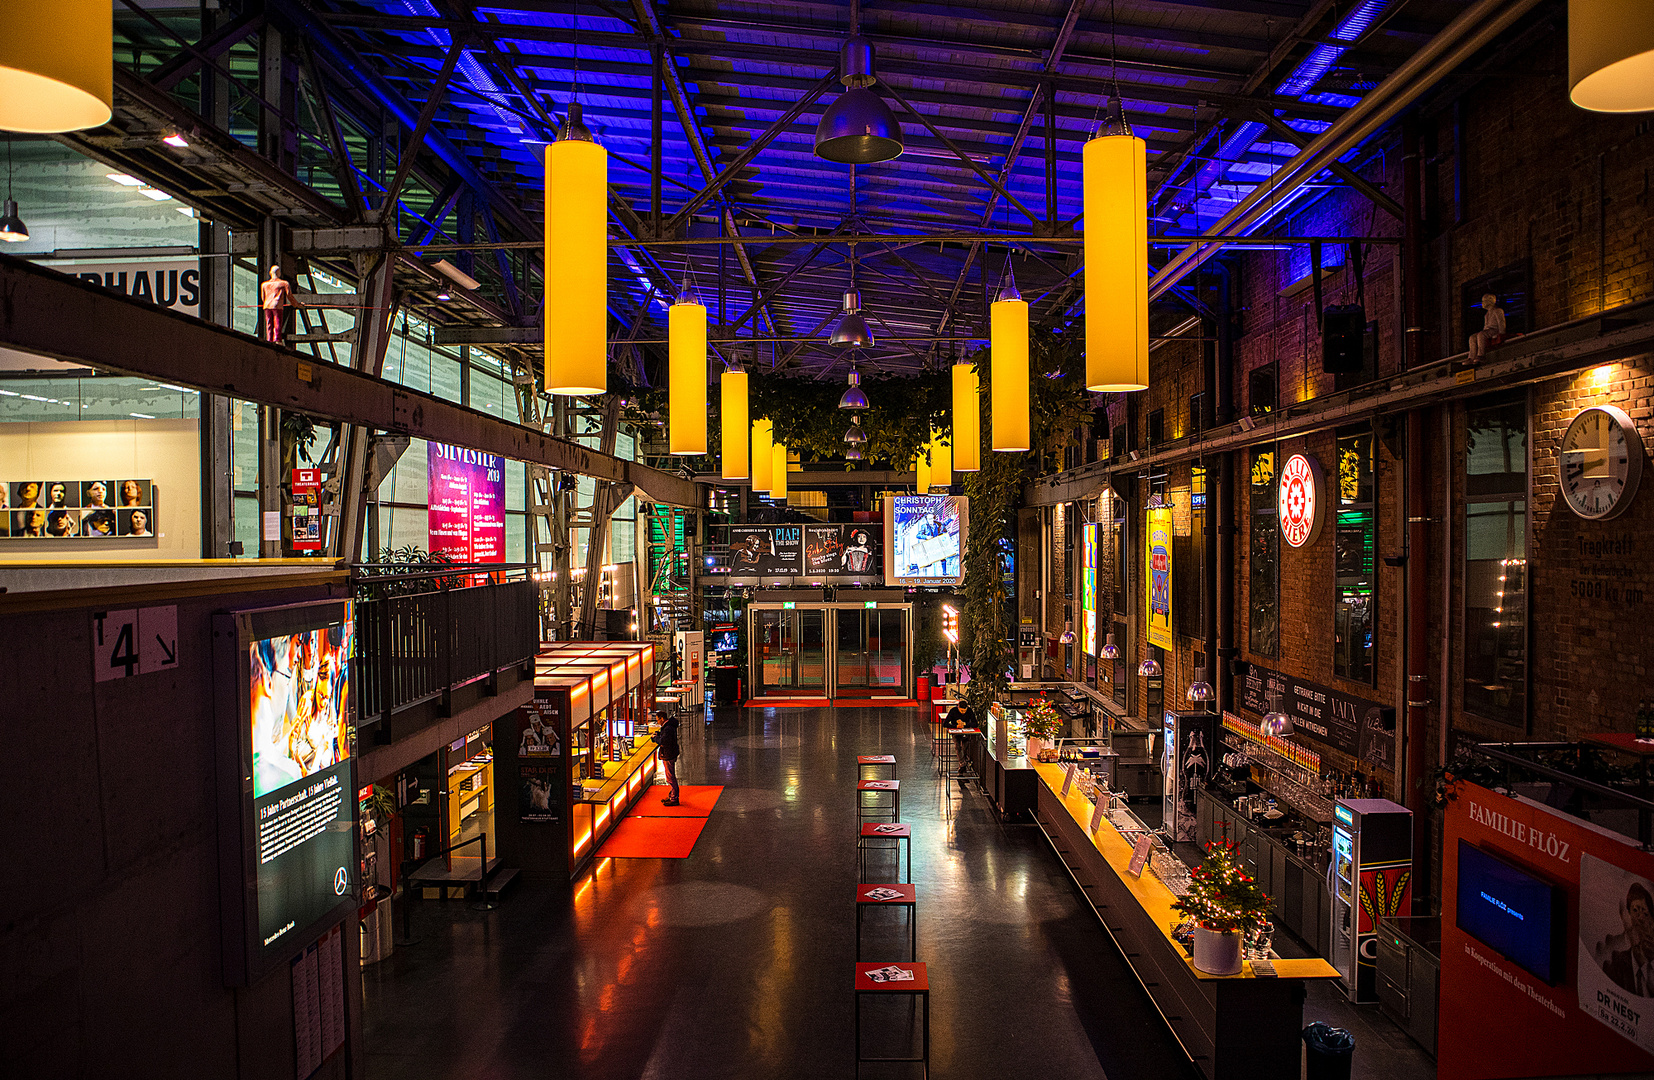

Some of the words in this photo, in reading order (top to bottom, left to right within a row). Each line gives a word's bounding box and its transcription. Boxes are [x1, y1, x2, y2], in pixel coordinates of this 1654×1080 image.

[894, 496, 942, 504] CHRISTOPH
[894, 506, 935, 514] SONNTAG
[775, 528, 800, 541] PIAF!
[1571, 581, 1601, 599] 5000
[1314, 691, 1326, 705] BITTE
[260, 808, 267, 820] 15
[267, 802, 280, 818] Jahre
[279, 788, 308, 811] Partnerschaft.
[307, 786, 314, 797] 15
[313, 781, 324, 796] Jahre
[1468, 801, 1526, 843] FAMILIE
[1528, 827, 1570, 863] FLÖZ
[1480, 890, 1496, 905] FAMILIE
[1464, 943, 1471, 956] in
[1471, 946, 1503, 980] Kooperation
[1503, 968, 1514, 986] mit
[1513, 972, 1527, 993] dem
[1527, 979, 1566, 1019] Theaterhaus
[1597, 990, 1611, 1008] DR
[1612, 1000, 1641, 1026] NEST
